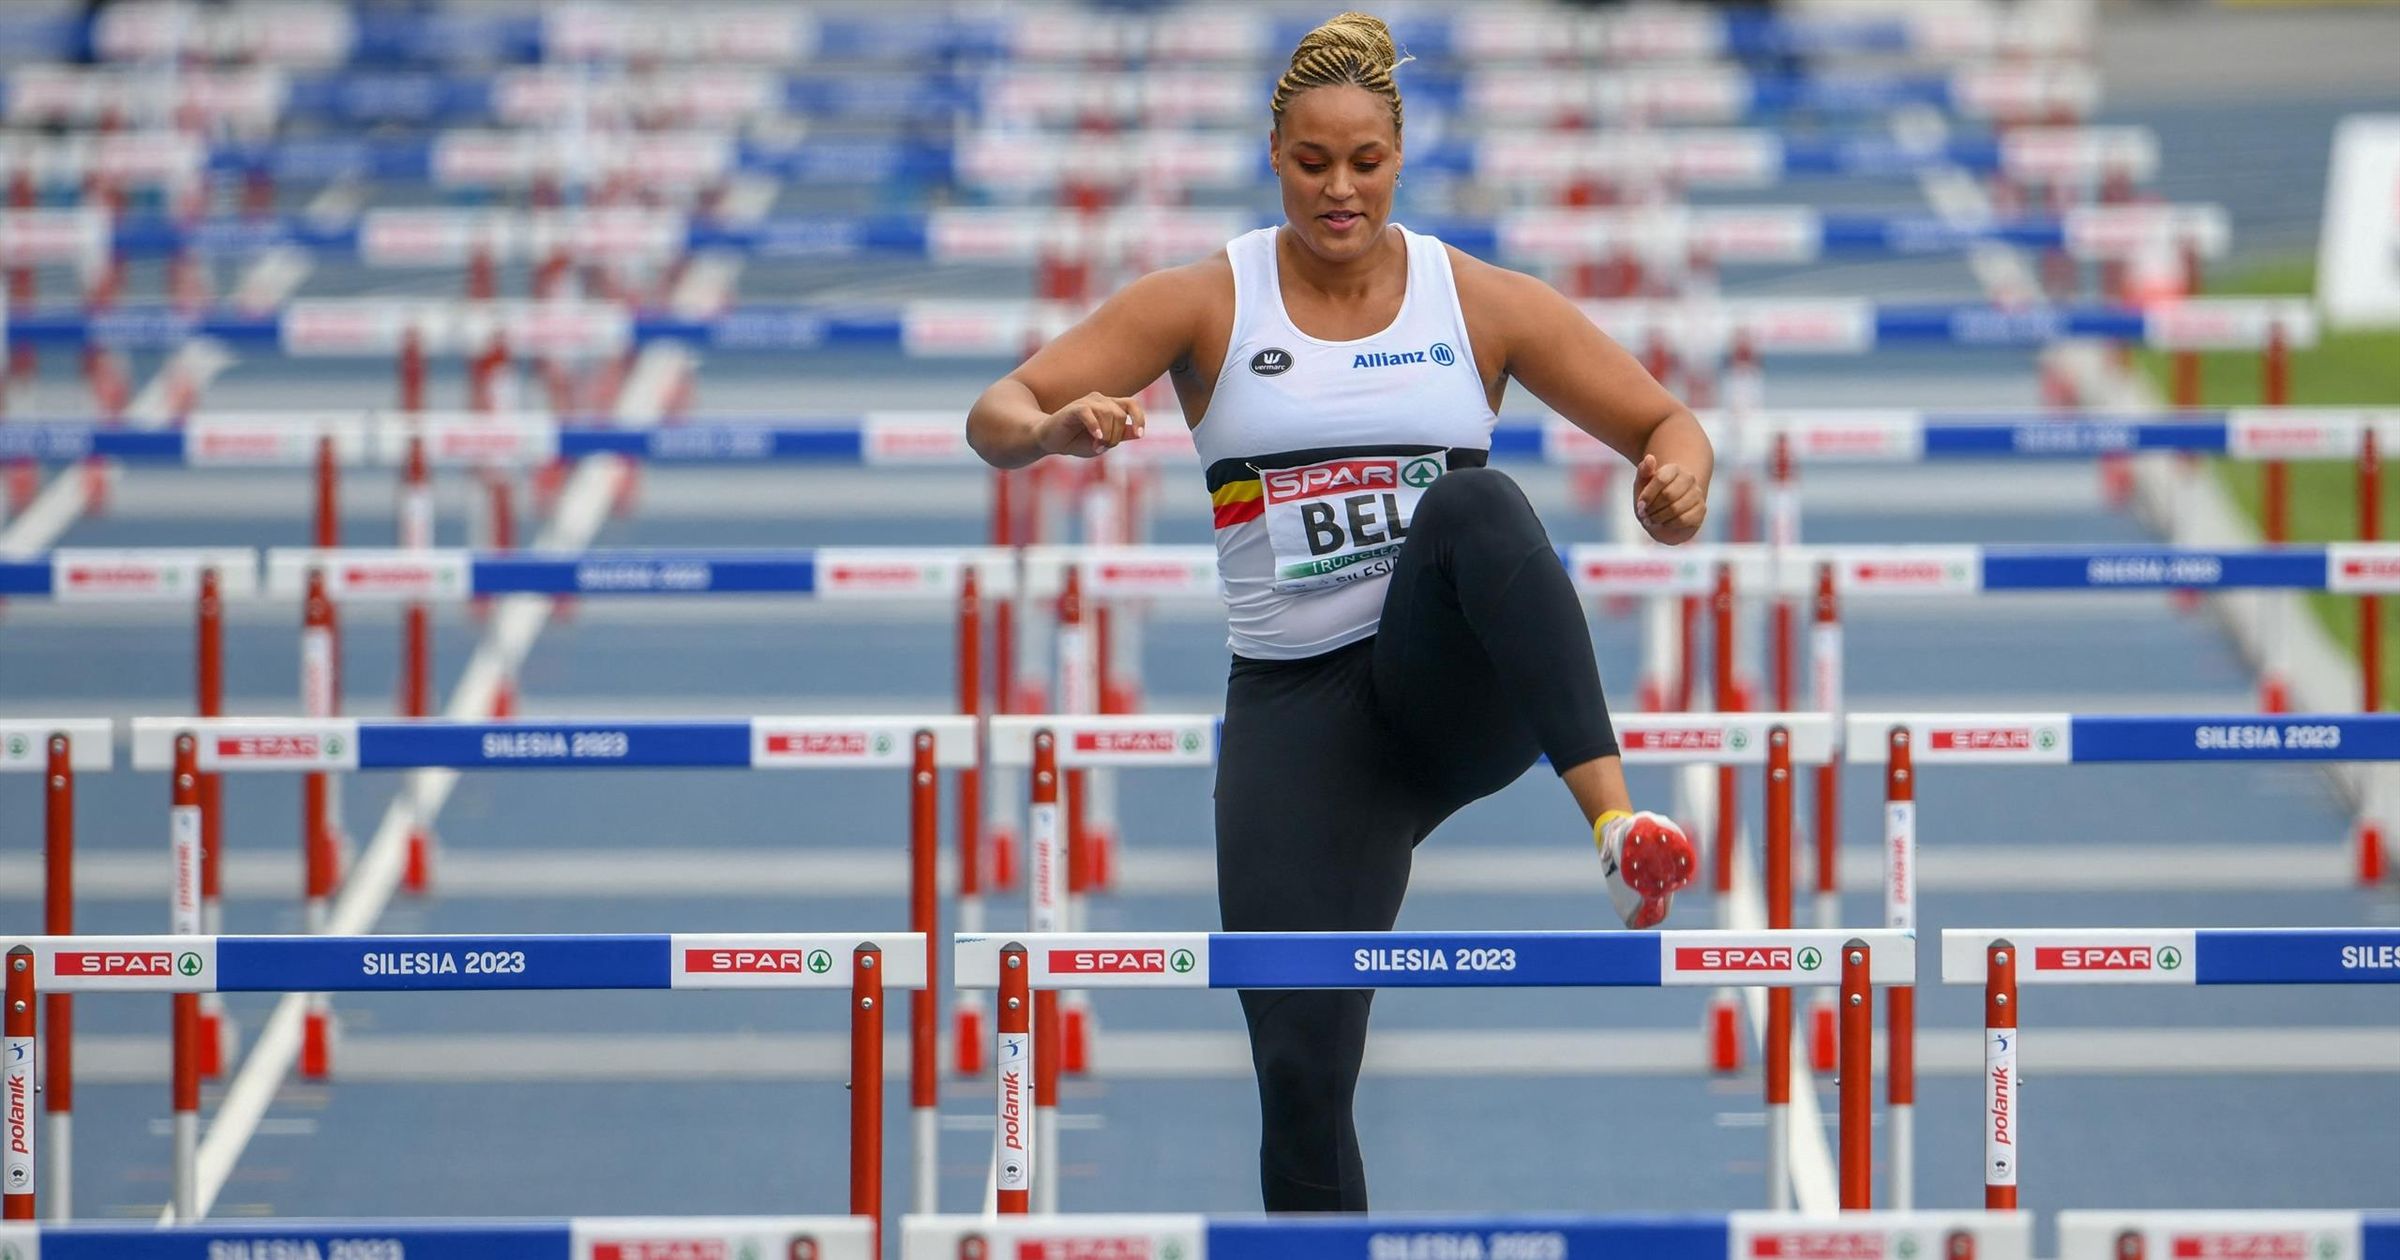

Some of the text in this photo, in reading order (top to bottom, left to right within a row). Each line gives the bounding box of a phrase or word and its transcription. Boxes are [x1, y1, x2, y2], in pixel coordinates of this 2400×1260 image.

[1353, 351, 1427, 369] Allianz
[1270, 466, 1394, 498] SPAR
[1301, 493, 1408, 556] BEL
[1320, 555, 1355, 573] RUN
[1359, 545, 1401, 559] CLEA
[482, 731, 629, 758] SILESIA 2023
[1643, 731, 1722, 750] SPAR
[1952, 730, 2030, 750] SPAR
[2195, 725, 2341, 749] SILESIA 2023
[81, 955, 171, 972] SPAR
[363, 951, 526, 975] SILESIA 2023
[712, 952, 800, 969] SPAR
[1075, 953, 1163, 970] SPAR
[1354, 949, 1517, 971] SILESIA 2023
[1702, 950, 1790, 967] SPAR
[2061, 950, 2149, 967] SPAR
[8, 1073, 29, 1154] polanik
[1002, 1070, 1023, 1150] polanik
[1991, 1065, 2012, 1145] polanik
